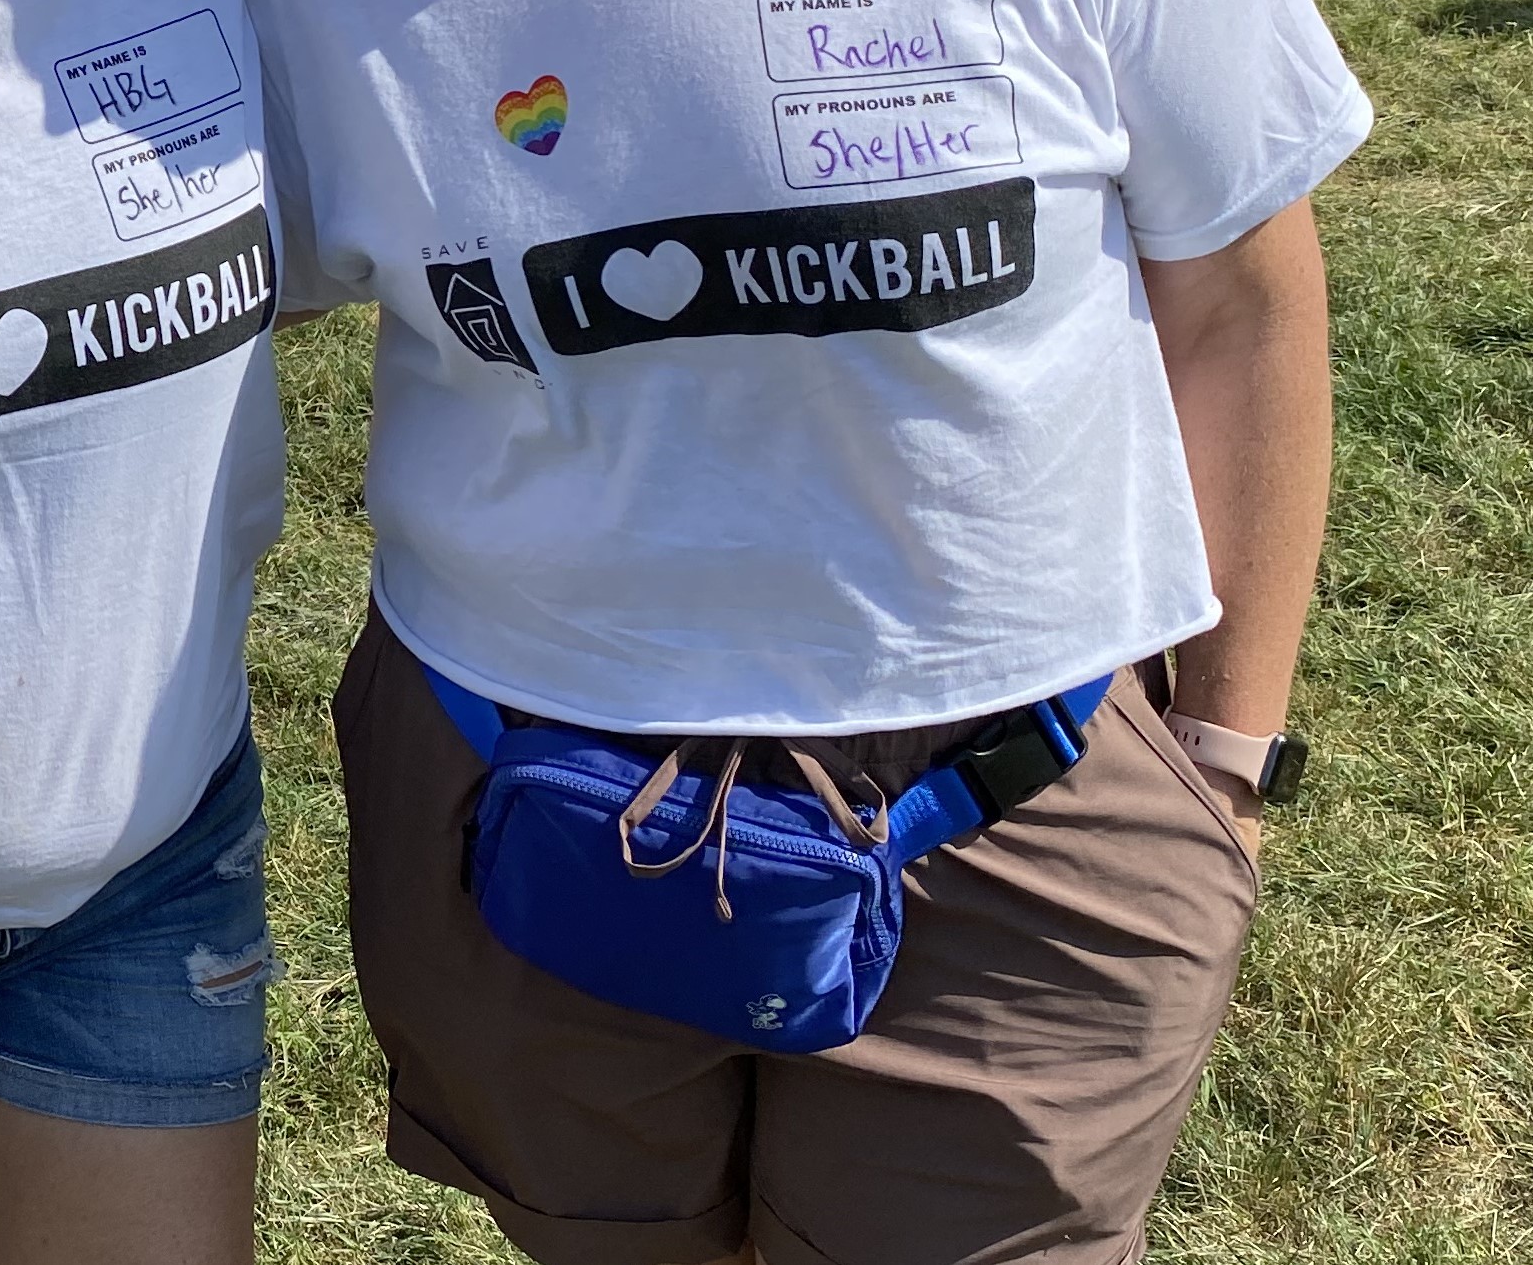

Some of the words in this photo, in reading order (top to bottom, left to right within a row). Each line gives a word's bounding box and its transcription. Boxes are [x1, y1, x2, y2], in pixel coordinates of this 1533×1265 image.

[770, 0, 795, 13] MY
[66, 64, 88, 80] MY
[91, 50, 132, 72] NAME
[133, 45, 147, 59] IS
[807, 17, 947, 72] Rachel
[88, 64, 177, 124] HBG
[785, 103, 811, 116] MY
[817, 94, 916, 114] PRONOUNS
[922, 90, 957, 105] ARE
[103, 158, 125, 175] MY
[128, 134, 198, 166] PRONOUNS
[200, 124, 221, 142] ARE
[421, 235, 489, 260] SAVE
[563, 275, 591, 329] I
[724, 219, 1016, 306] KICKBALL
[67, 244, 271, 368] KICKBALL
